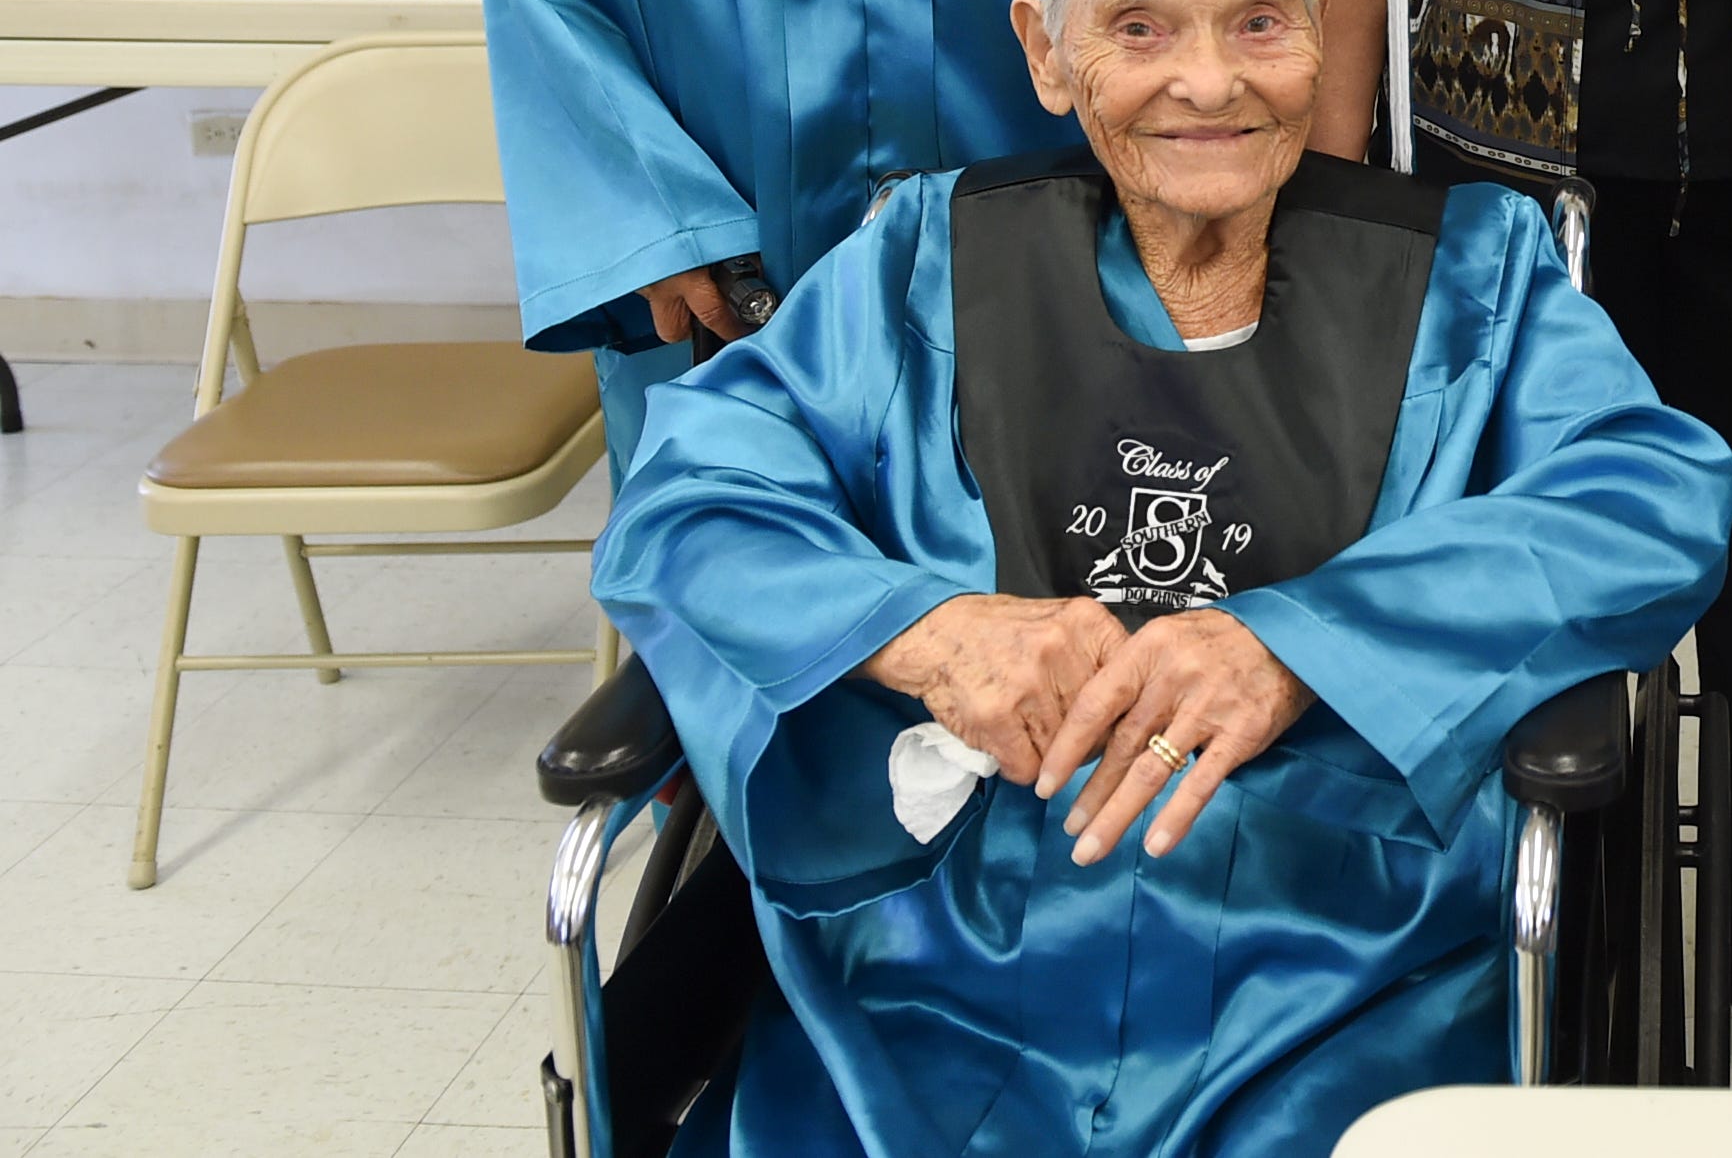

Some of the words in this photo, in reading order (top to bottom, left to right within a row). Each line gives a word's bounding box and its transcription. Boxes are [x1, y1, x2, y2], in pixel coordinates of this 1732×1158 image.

[1117, 439, 1193, 480] Class
[1191, 456, 1230, 492] of
[1065, 504, 1107, 536] 20
[1221, 523, 1252, 554] 19
[1122, 511, 1208, 550] SOUTHERN
[1139, 497, 1190, 571] S
[1125, 587, 1190, 608] DOLPHINS
